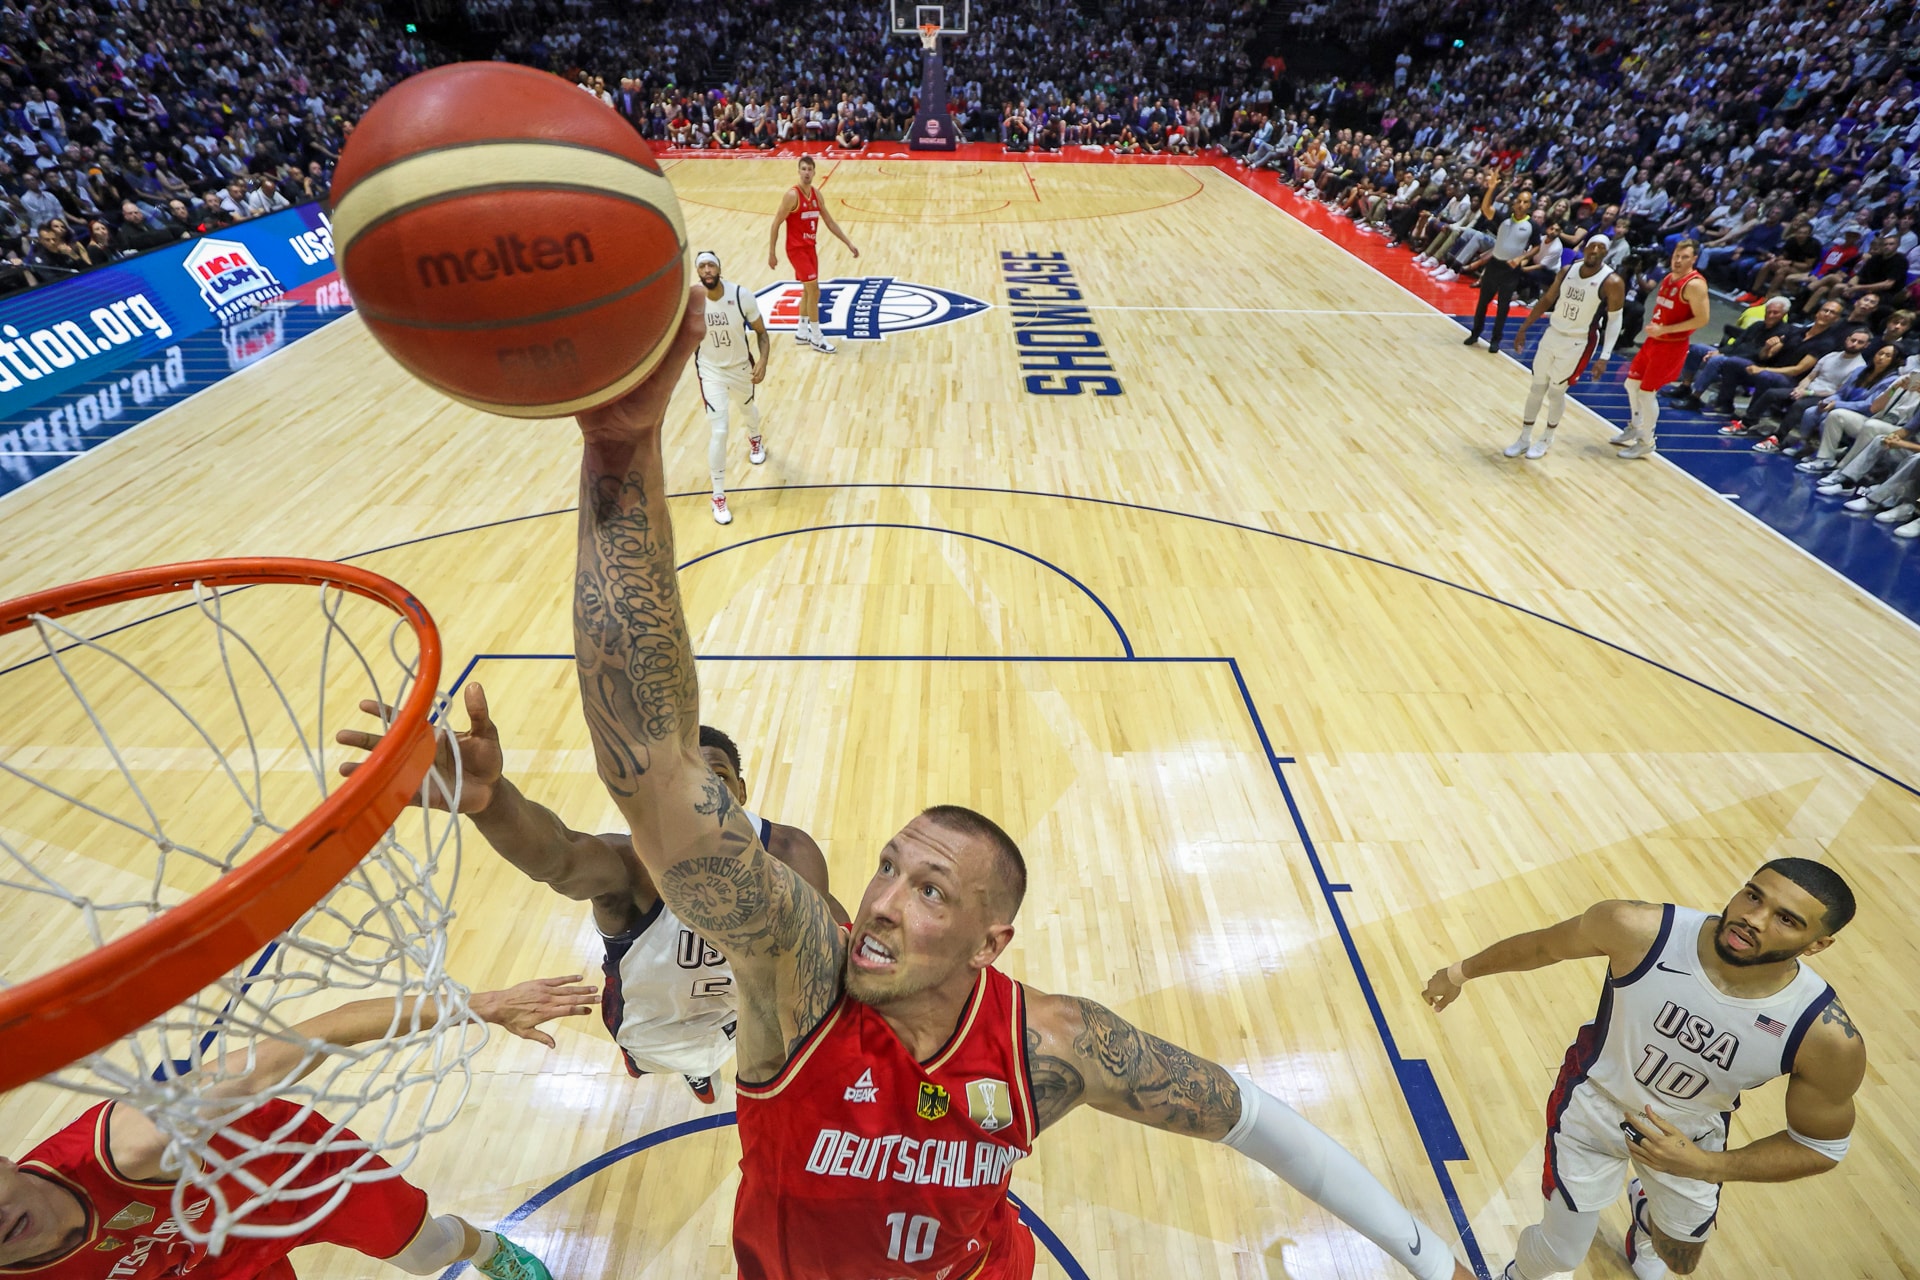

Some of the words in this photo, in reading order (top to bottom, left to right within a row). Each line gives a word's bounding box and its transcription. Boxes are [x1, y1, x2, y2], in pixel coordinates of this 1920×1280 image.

[416, 231, 595, 288] molten
[708, 312, 729, 326] USA
[853, 280, 883, 336] BASKETBALL
[1563, 302, 1579, 321] 13
[1565, 287, 1586, 301] USA
[709, 330, 732, 348] 14
[1000, 251, 1125, 396] SHOWCASE
[1653, 1000, 1740, 1072] USA
[843, 1086, 880, 1103] PEAK
[1634, 1043, 1710, 1100] 10
[886, 1212, 941, 1263] 10
